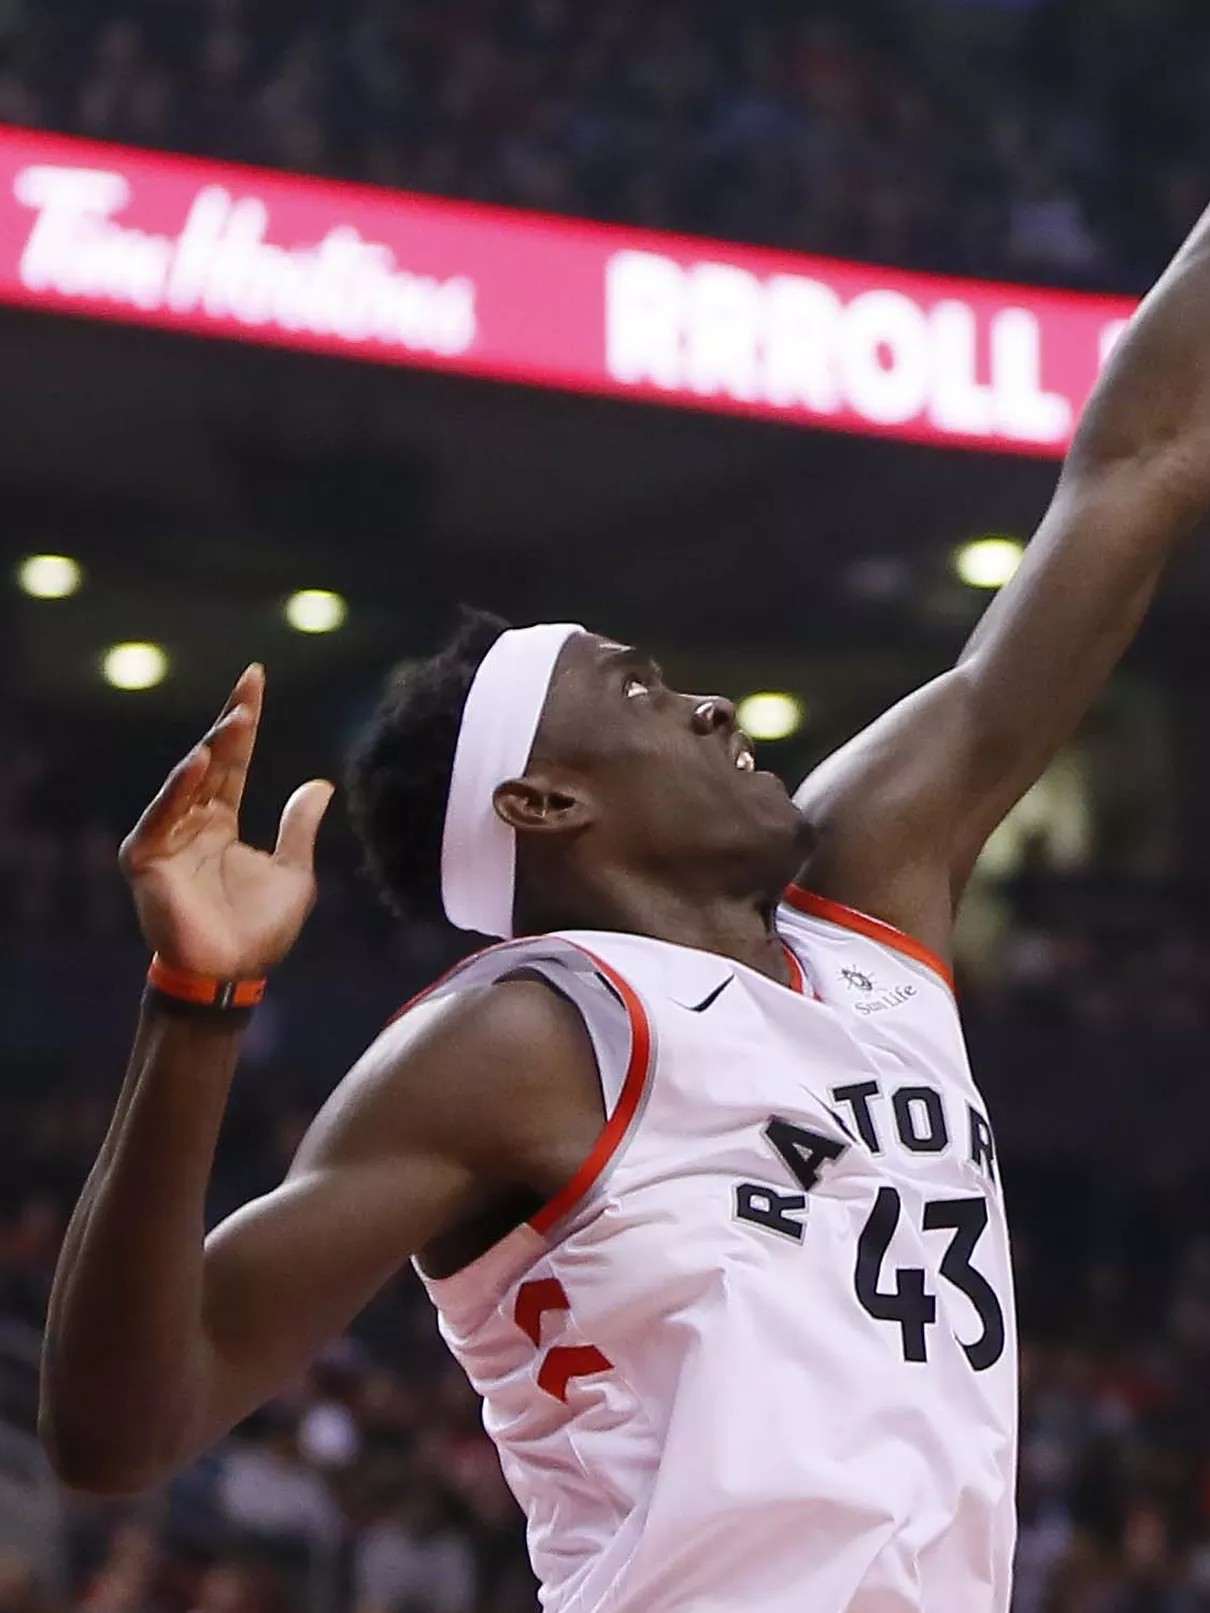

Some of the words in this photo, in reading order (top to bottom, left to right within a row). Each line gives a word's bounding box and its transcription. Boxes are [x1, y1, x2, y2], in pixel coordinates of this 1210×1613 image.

[604, 250, 1072, 442] RRROLL
[881, 985, 918, 1008] Life
[730, 1078, 998, 1246] RATOR
[853, 1186, 1005, 1372] 43
